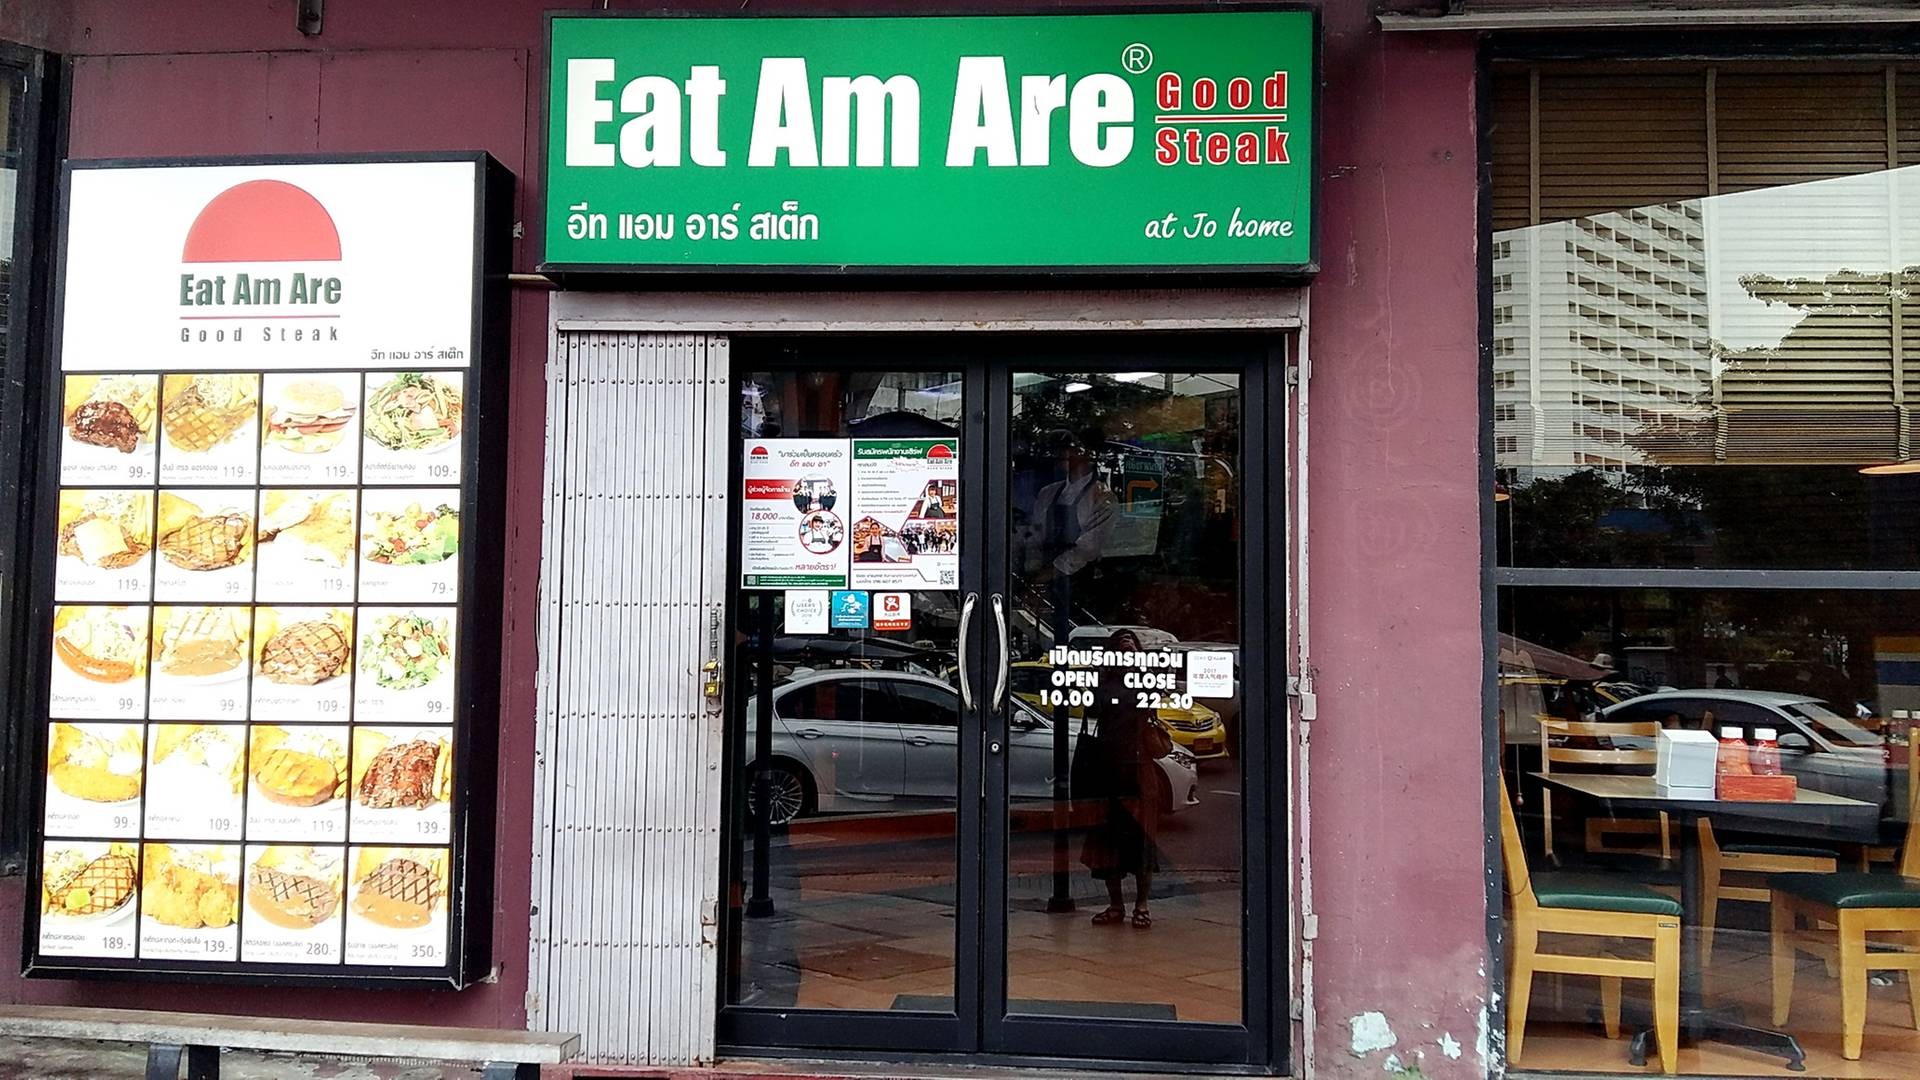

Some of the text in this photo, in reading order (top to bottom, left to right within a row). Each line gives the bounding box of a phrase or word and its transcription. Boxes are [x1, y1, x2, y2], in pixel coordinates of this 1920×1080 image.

[1156, 71, 1288, 110] Good
[565, 58, 727, 168] Eat
[747, 57, 921, 168] Am
[945, 56, 1134, 168] Are
[1155, 126, 1290, 166] Steak
[567, 202, 607, 240] อีท
[618, 213, 675, 240] แอม
[686, 203, 740, 240] อาร์
[1145, 207, 1294, 238] at Jo home
[179, 272, 342, 306] Eat Am Are
[181, 326, 338, 342] Good Steak
[389, 351, 410, 360] แอม
[1049, 645, 1183, 672] เปิดบริการทุกวัน
[1051, 671, 1099, 688] OPEN
[1123, 672, 1176, 689] CLOSE
[1039, 689, 1094, 707] 10.00
[1136, 693, 1193, 710] 22.30
[102, 936, 131, 950] 189.-
[203, 939, 232, 953] 139.-
[306, 942, 337, 956] 280.-
[411, 945, 442, 958] 350.-
